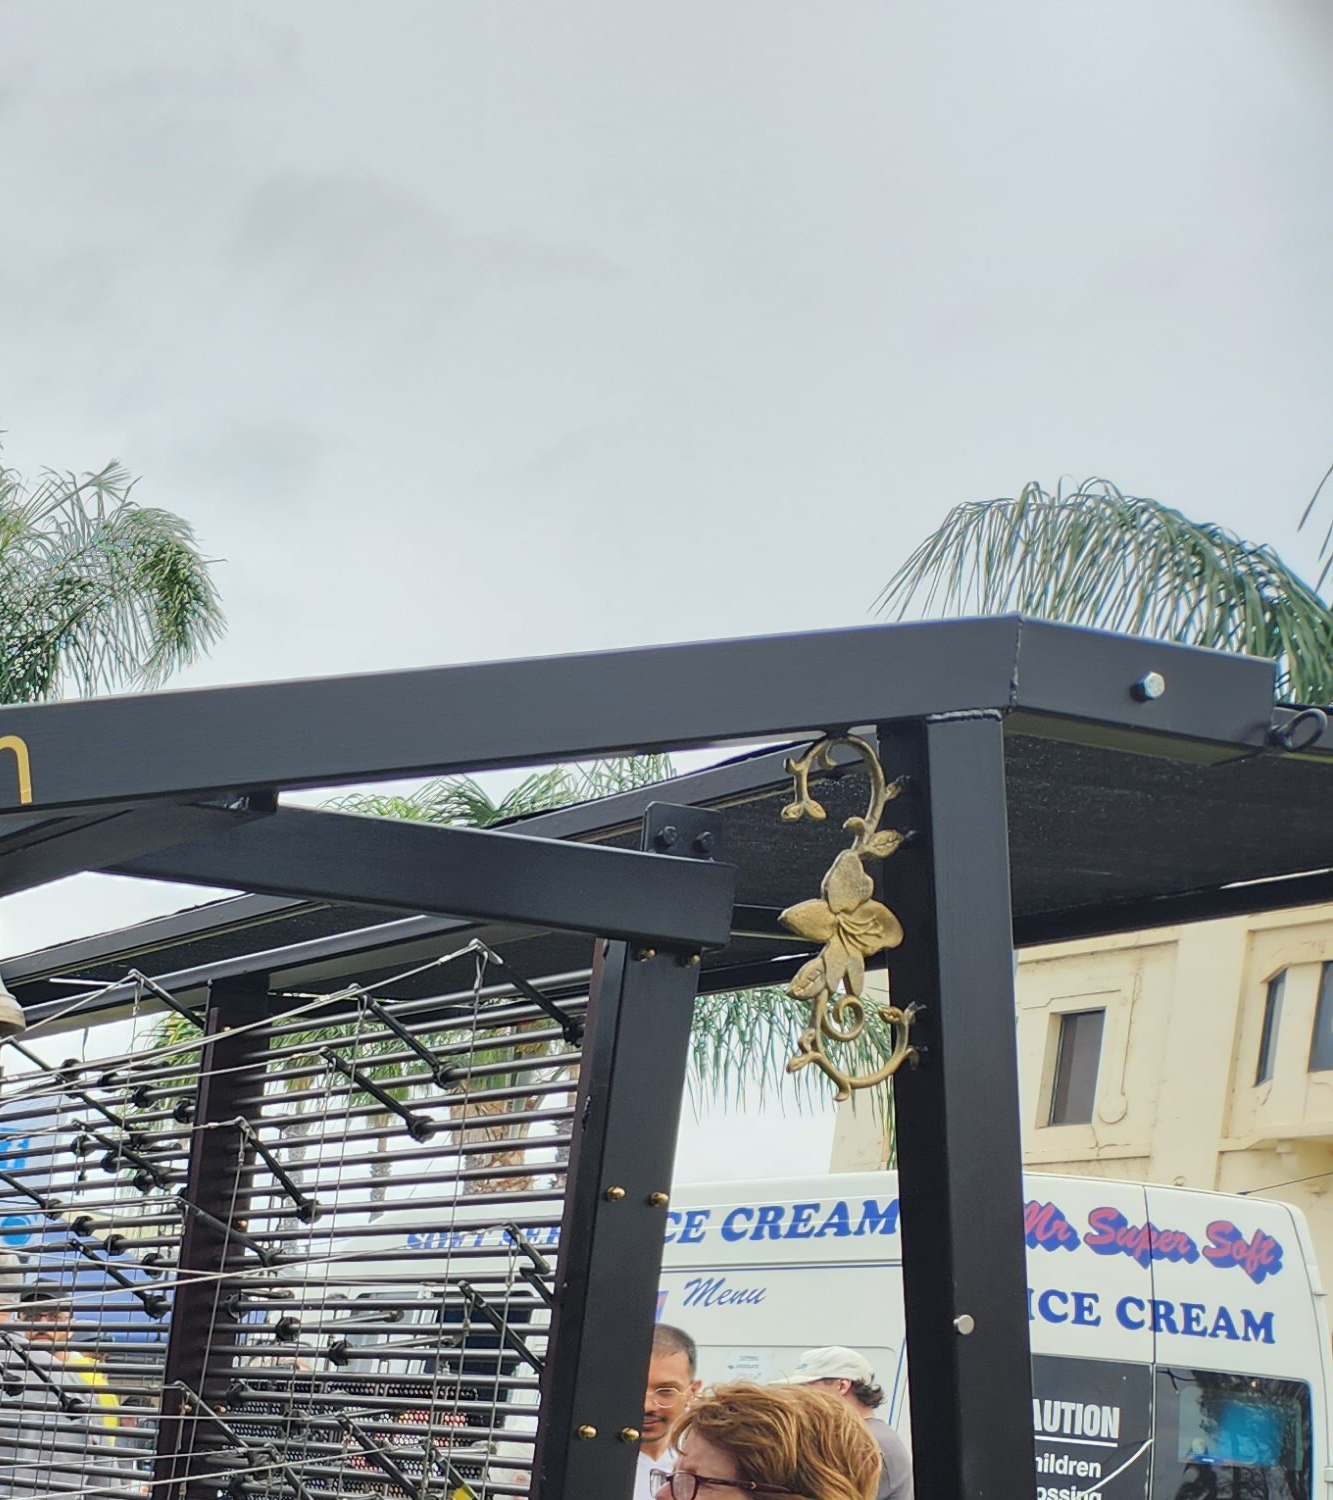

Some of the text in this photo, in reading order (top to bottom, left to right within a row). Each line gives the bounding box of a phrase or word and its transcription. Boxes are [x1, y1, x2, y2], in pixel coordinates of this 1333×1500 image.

[721, 1199, 900, 1243] CREAM
[1024, 1200, 1284, 1285] Mr Super Soft
[683, 1277, 767, 1308] Menu
[1115, 1296, 1276, 1345] CREAM
